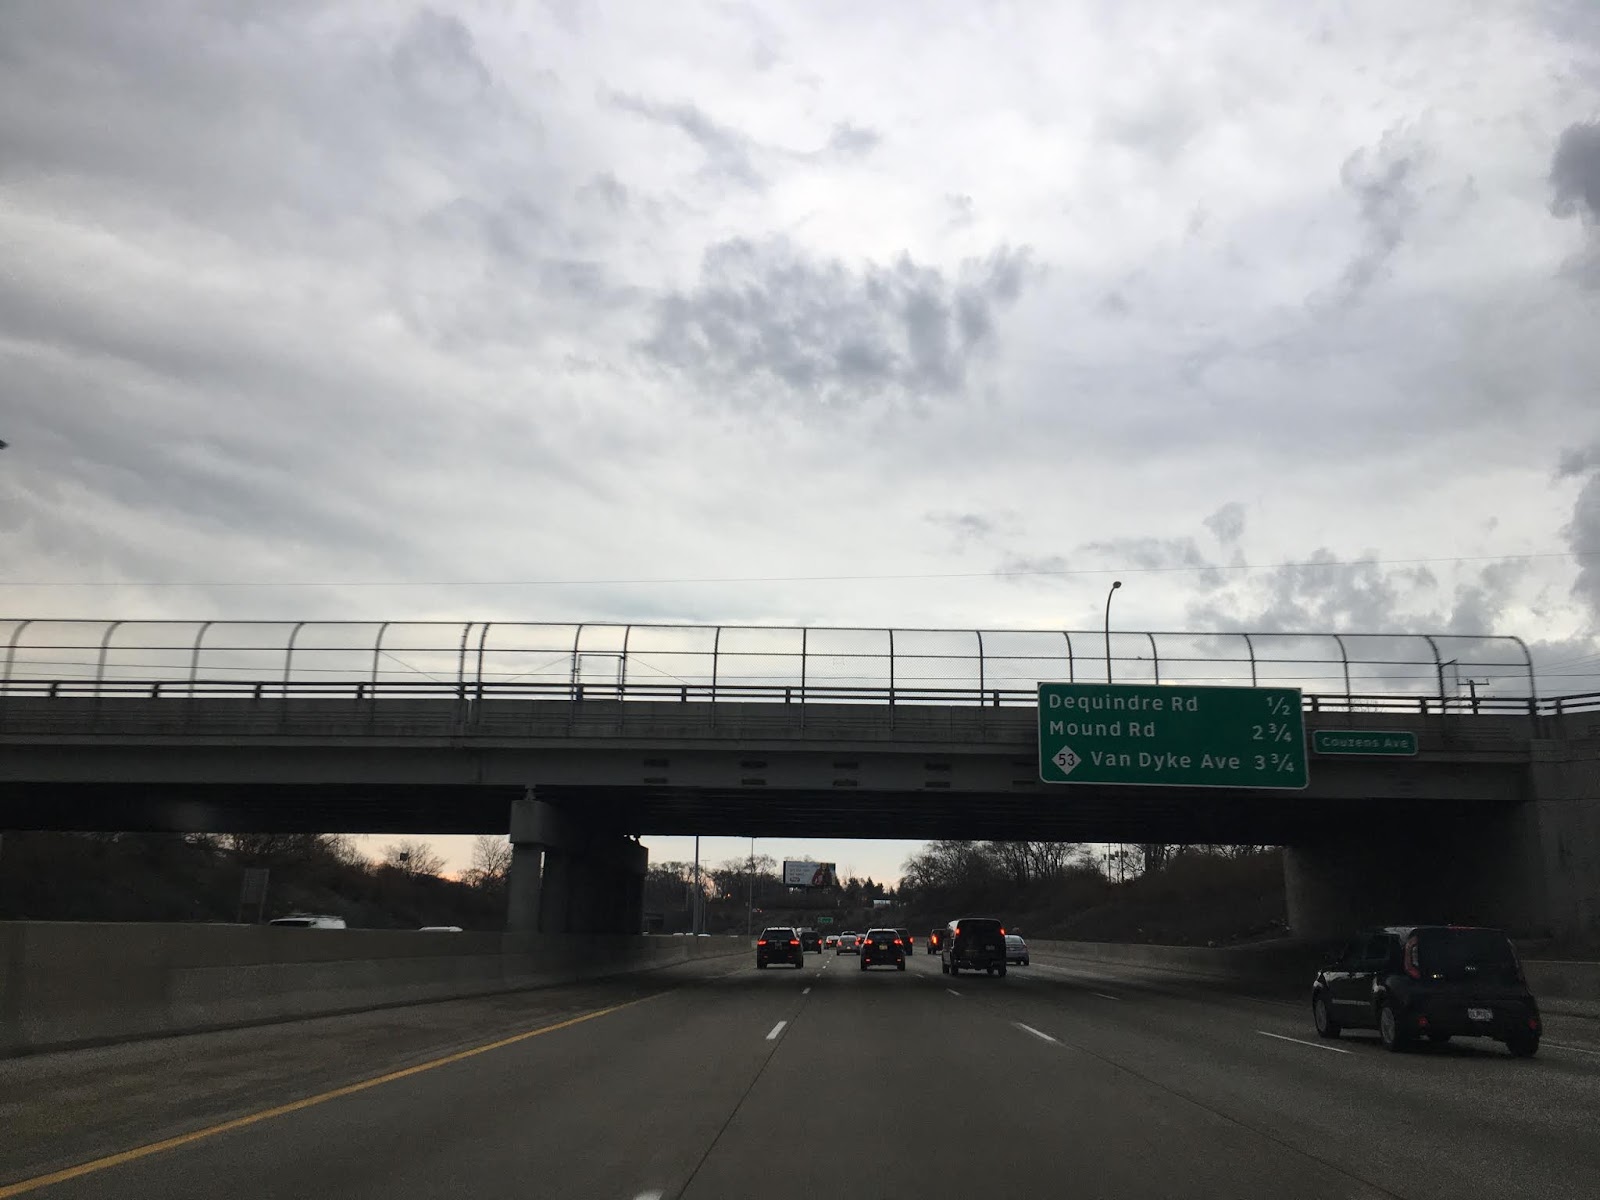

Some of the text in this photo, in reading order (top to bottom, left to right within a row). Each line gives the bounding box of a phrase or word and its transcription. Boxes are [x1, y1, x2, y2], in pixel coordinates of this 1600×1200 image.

[1049, 694, 1164, 712] Dequindre
[1171, 696, 1198, 712] Rd
[1049, 720, 1121, 737] Mound
[1129, 722, 1156, 737] Rd
[1383, 738, 1409, 749] Ave
[1058, 753, 1075, 767] 53
[1091, 751, 1131, 767] Van
[1139, 752, 1191, 771] Dyke
[1200, 754, 1240, 770] Ave
